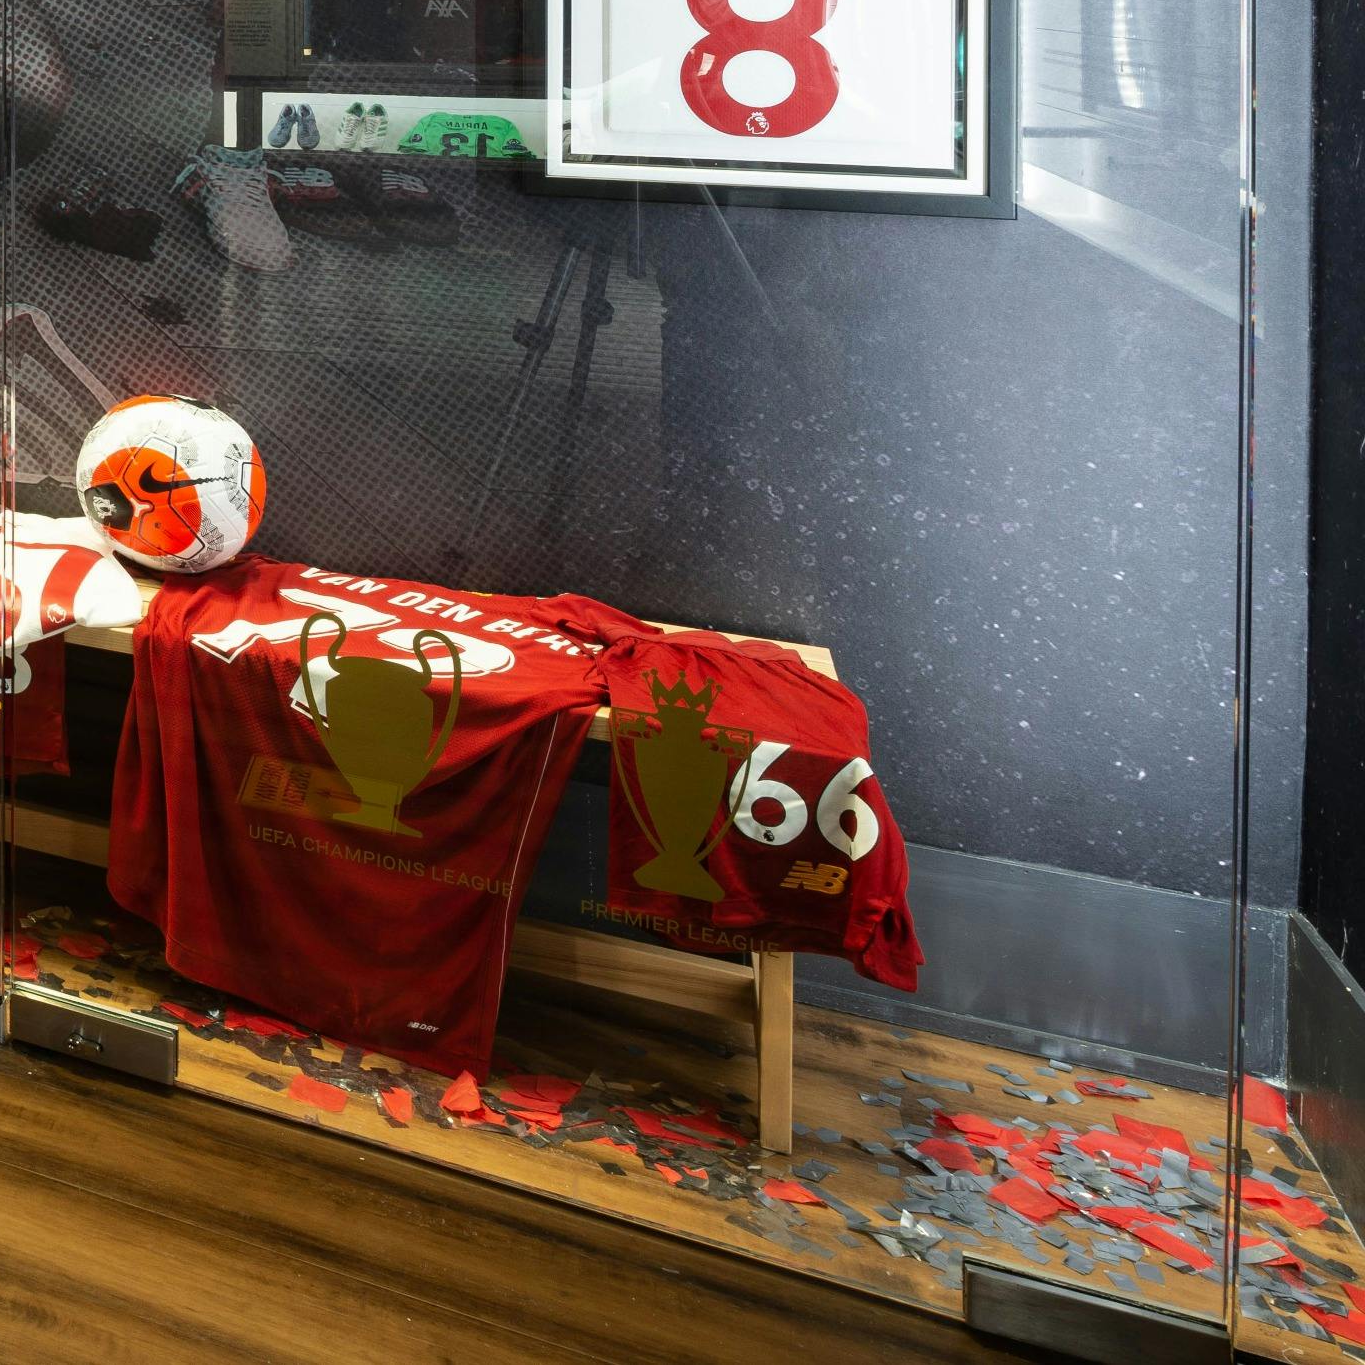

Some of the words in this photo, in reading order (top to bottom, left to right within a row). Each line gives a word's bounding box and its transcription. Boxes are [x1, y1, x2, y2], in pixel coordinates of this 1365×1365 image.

[299, 567, 389, 596] VAN
[387, 591, 483, 624] DEN
[728, 740, 880, 862] 66
[248, 824, 297, 848] UEFA
[302, 835, 425, 877] CHAMPIONS
[430, 865, 514, 897] LEAGUE
[580, 899, 679, 936] PREMIER
[688, 923, 781, 958] LEAGUE
